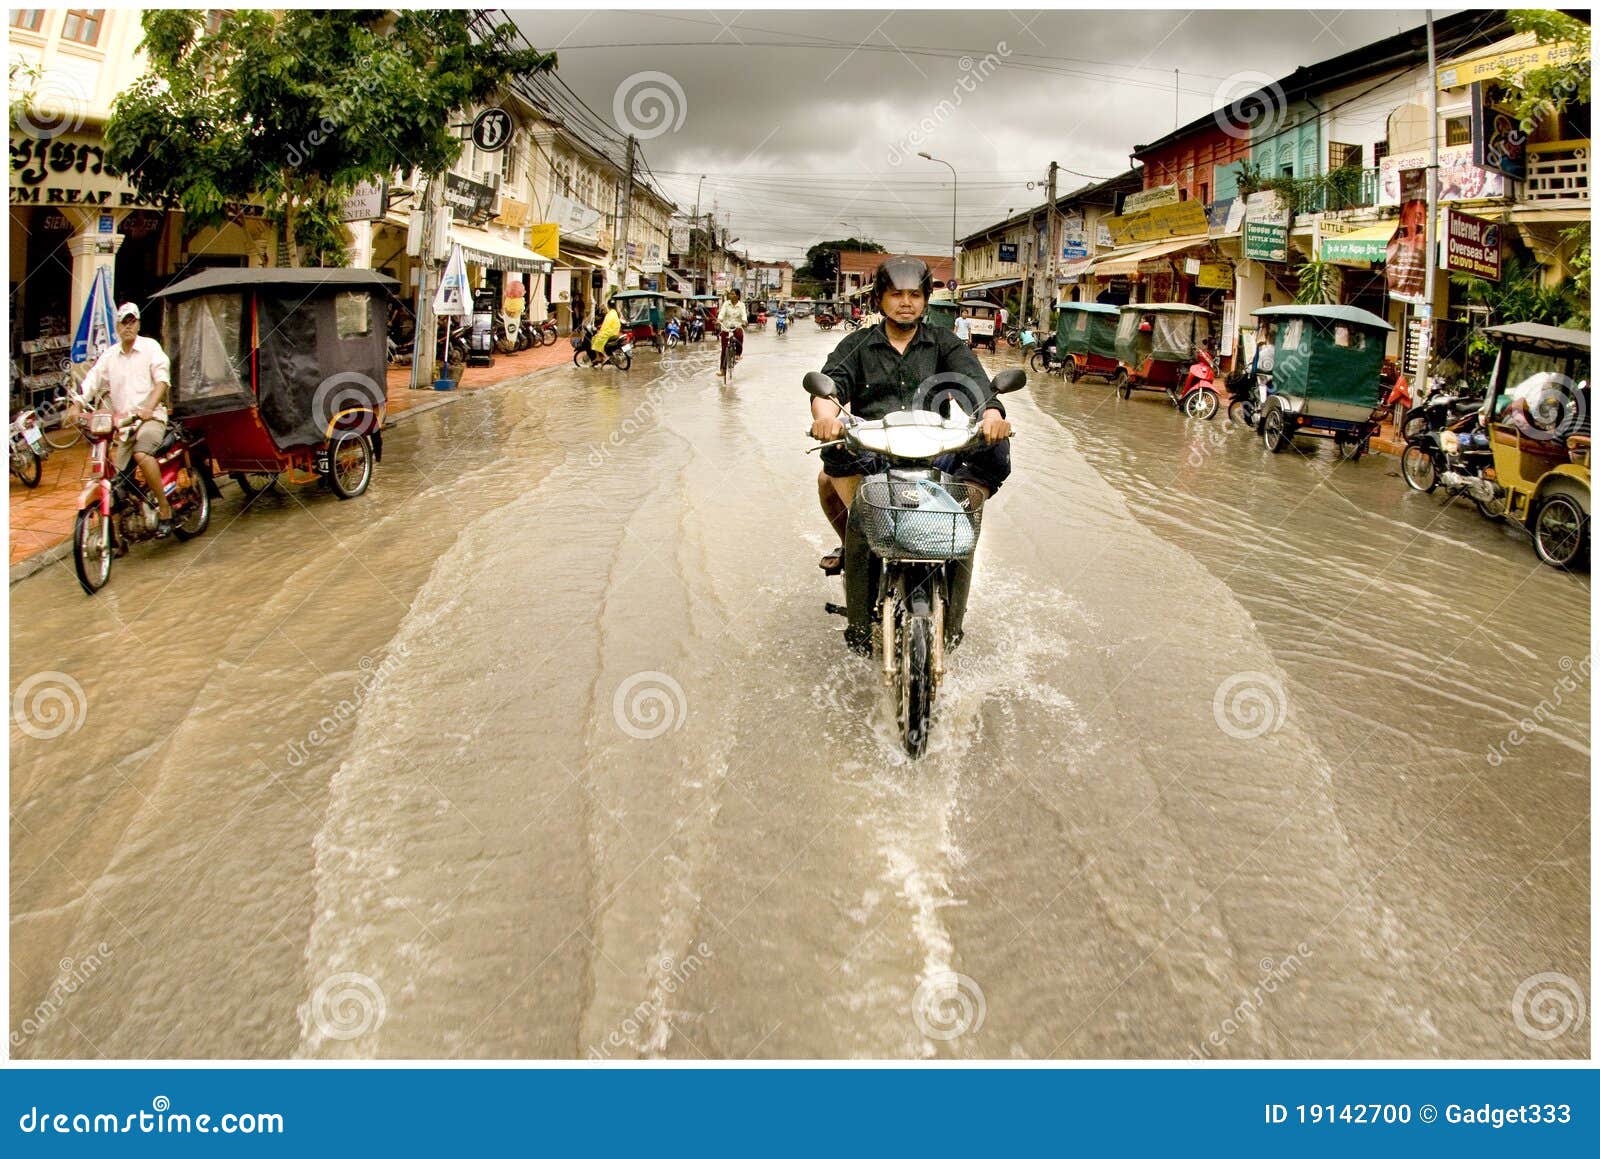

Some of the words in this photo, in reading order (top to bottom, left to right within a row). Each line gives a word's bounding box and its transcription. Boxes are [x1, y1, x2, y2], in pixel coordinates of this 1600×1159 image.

[47, 188, 112, 205] REAP
[1320, 222, 1344, 234] LITTLE
[1450, 212, 1480, 242] Internet
[1450, 237, 1483, 260] Overseas
[1484, 247, 1498, 264] Call
